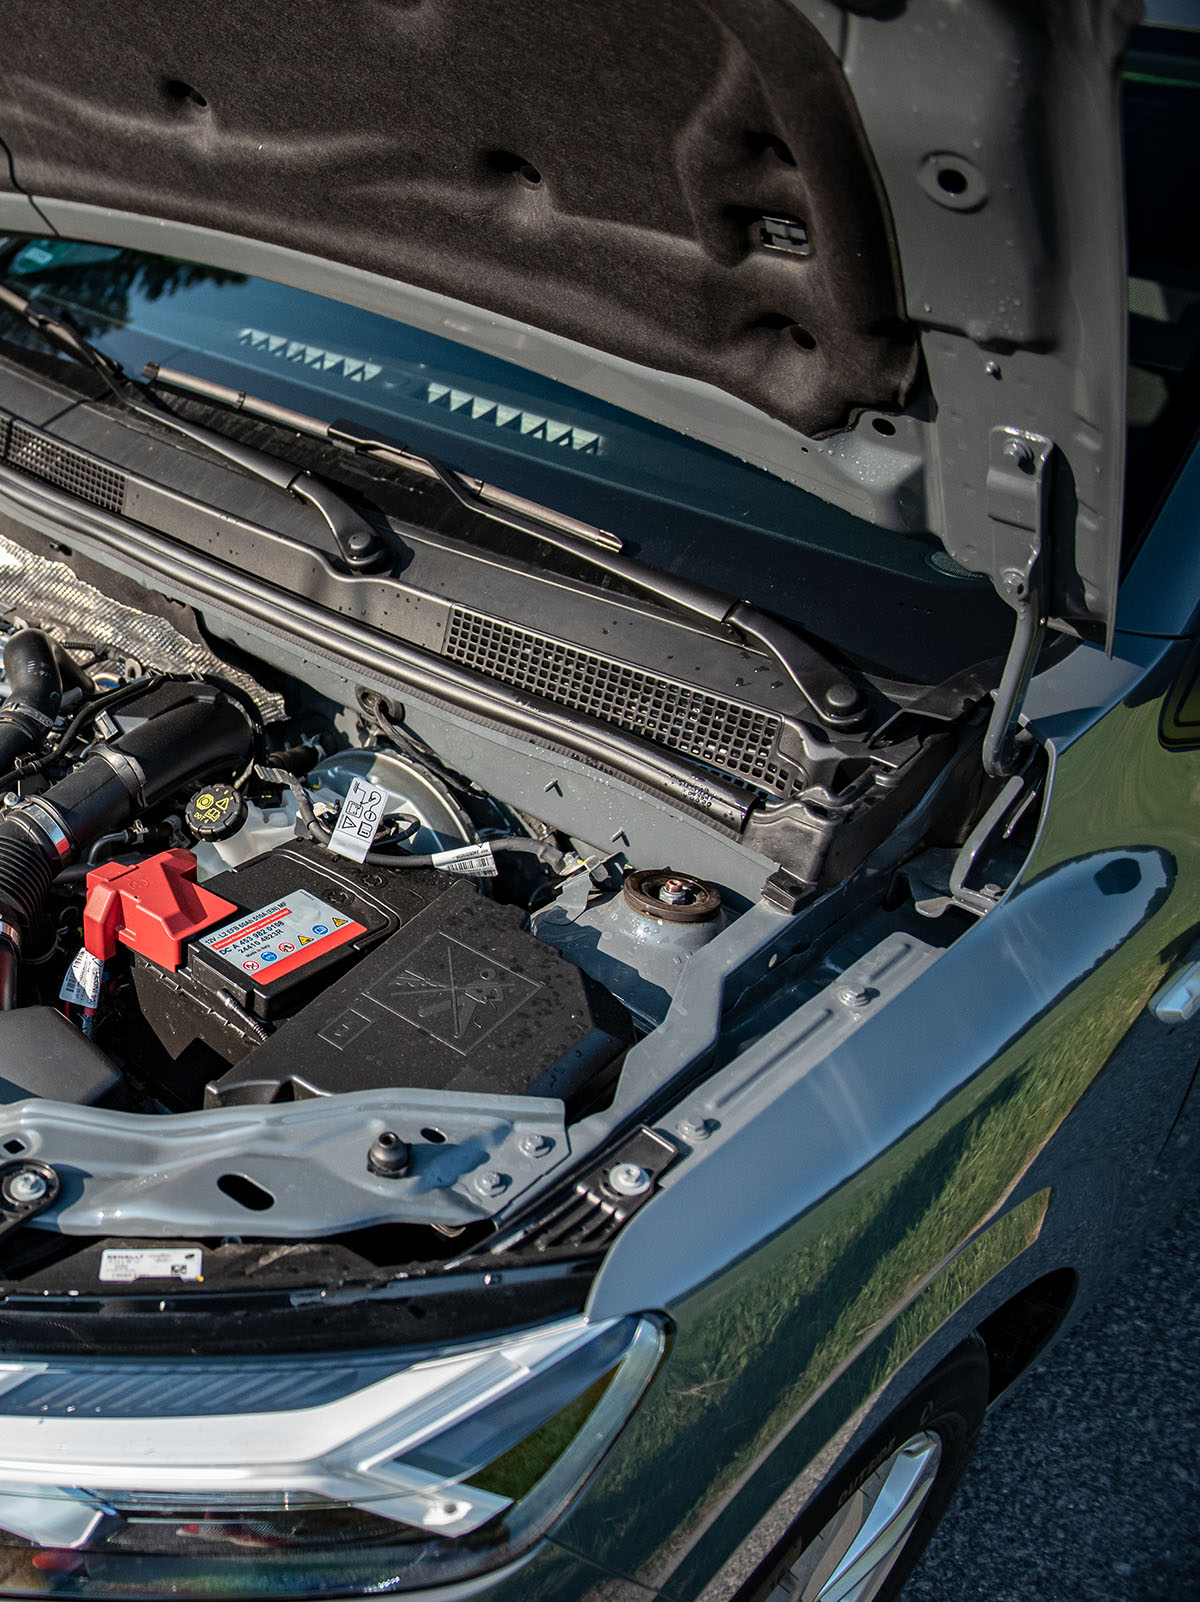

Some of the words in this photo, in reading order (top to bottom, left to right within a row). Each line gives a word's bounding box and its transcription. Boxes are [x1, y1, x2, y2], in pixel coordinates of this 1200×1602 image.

[205, 936, 217, 945] 12V
[226, 926, 240, 934] EFB
[238, 940, 261, 954] 24410
[260, 928, 284, 942] 4823R
[239, 936, 254, 946] 453
[252, 929, 268, 939] 982
